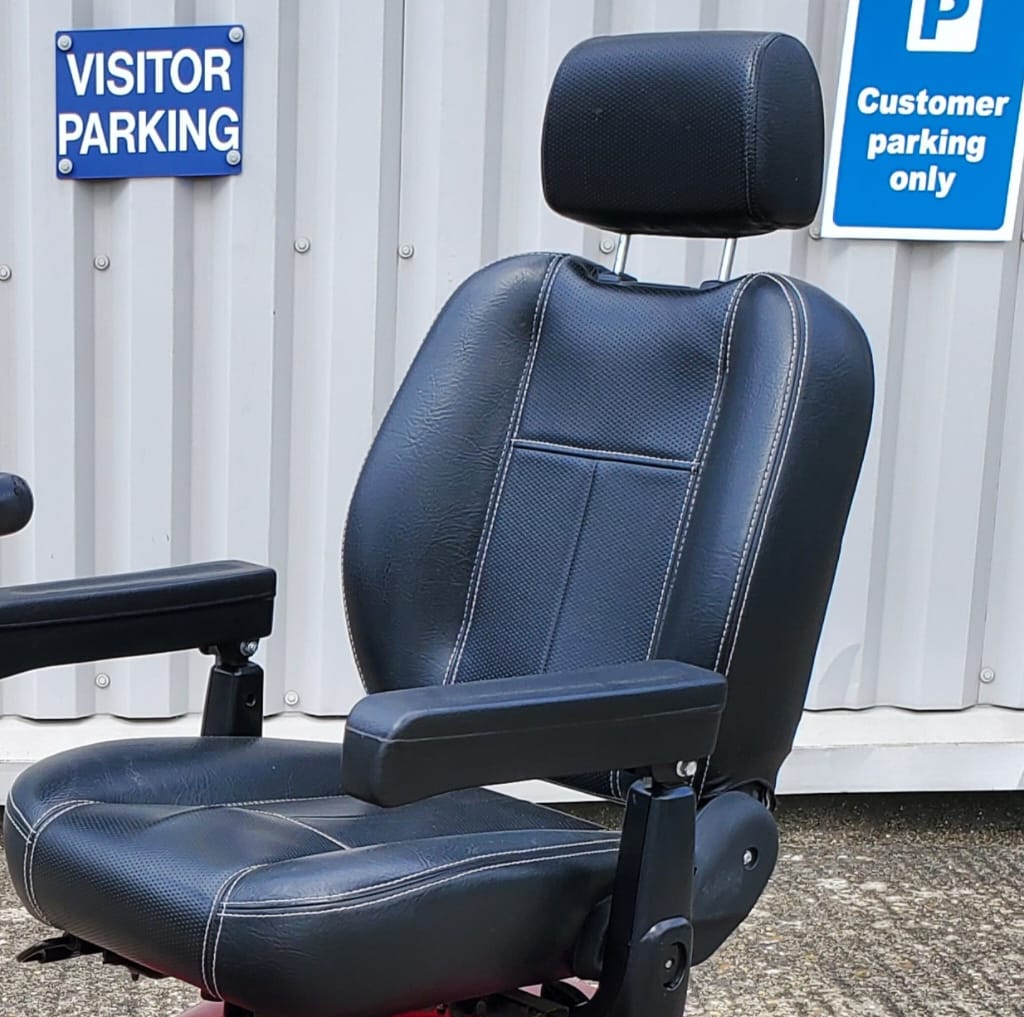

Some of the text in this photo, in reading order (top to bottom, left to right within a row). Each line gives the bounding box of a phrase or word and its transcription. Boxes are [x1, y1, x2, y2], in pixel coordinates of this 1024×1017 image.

[919, 0, 970, 40] P
[66, 48, 231, 96] VISITOR
[857, 87, 1010, 117] Customer
[58, 106, 239, 155] PARKING
[867, 128, 987, 162] parking
[889, 165, 957, 198] only
